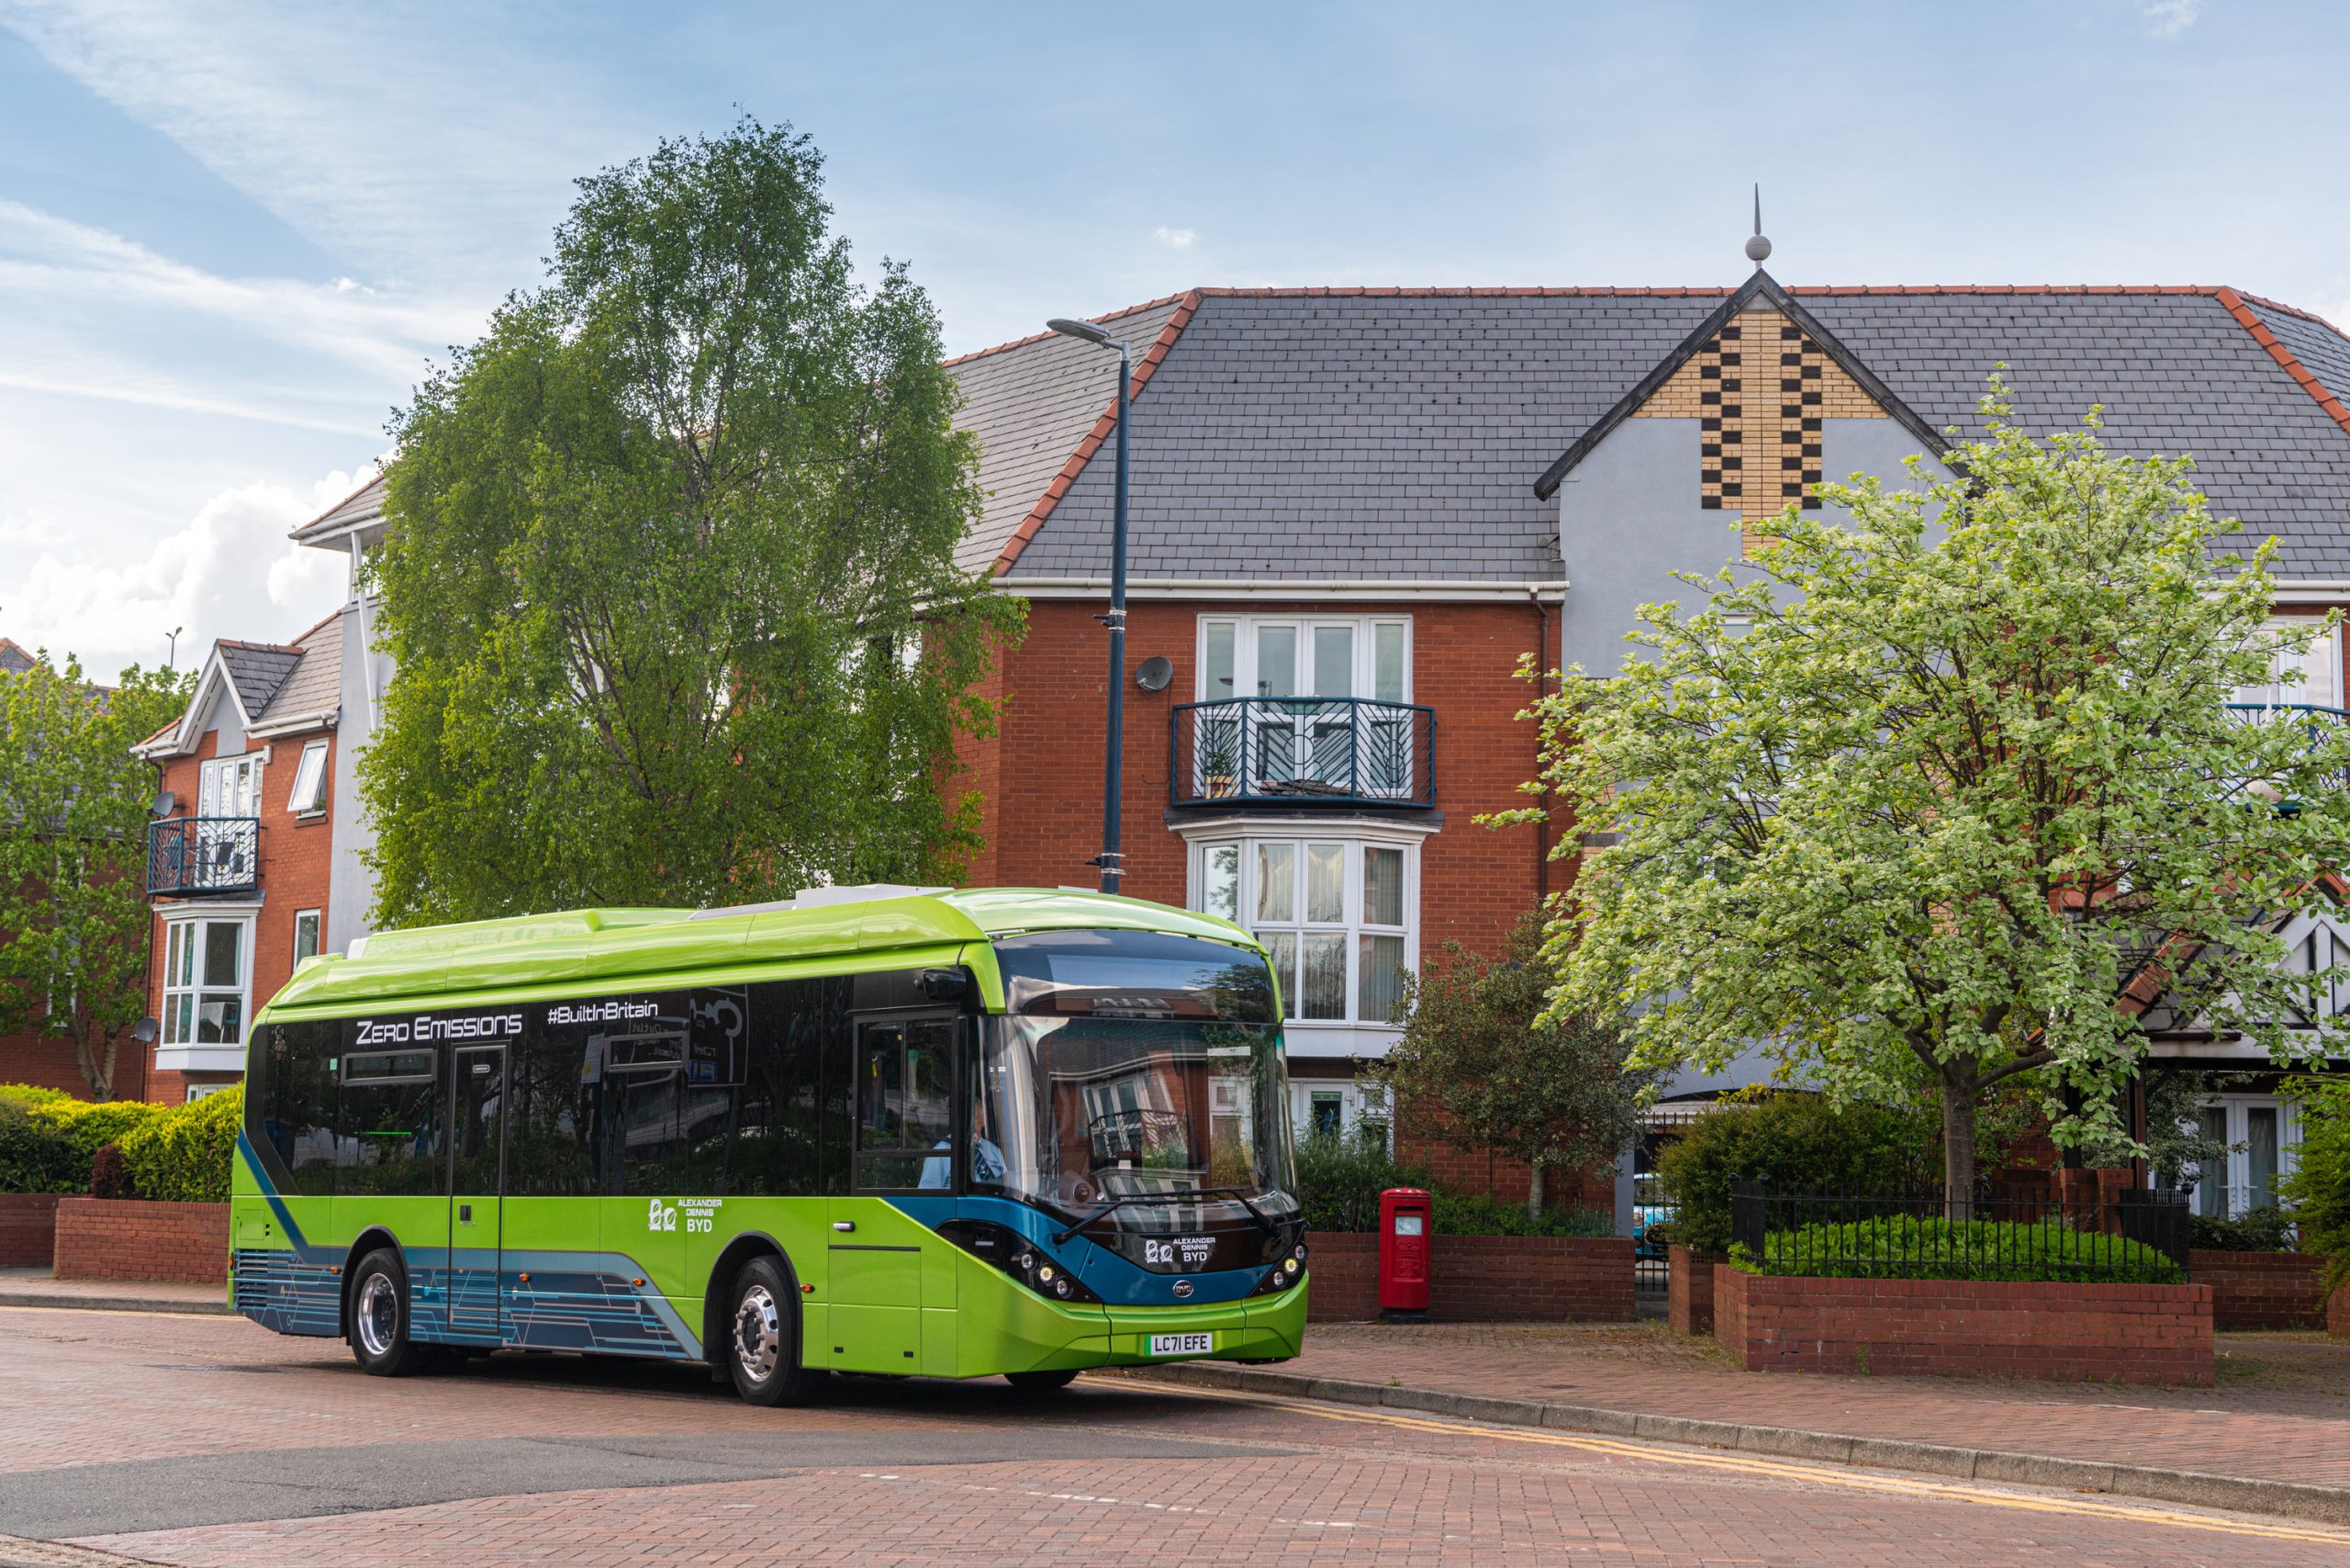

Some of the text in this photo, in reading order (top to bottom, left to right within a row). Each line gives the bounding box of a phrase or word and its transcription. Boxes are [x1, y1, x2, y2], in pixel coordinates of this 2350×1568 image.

[547, 1000, 658, 1025] #BuiltInBritain
[677, 1199, 722, 1207] ALEXANDER
[686, 1208, 714, 1216] DENNIS
[687, 1219, 712, 1232] BYD
[1173, 1237, 1216, 1245] ALEXANDER
[1183, 1251, 1207, 1262] BYD
[1175, 1285, 1192, 1294] BYD
[1155, 1335, 1208, 1351] LC71 EFE
